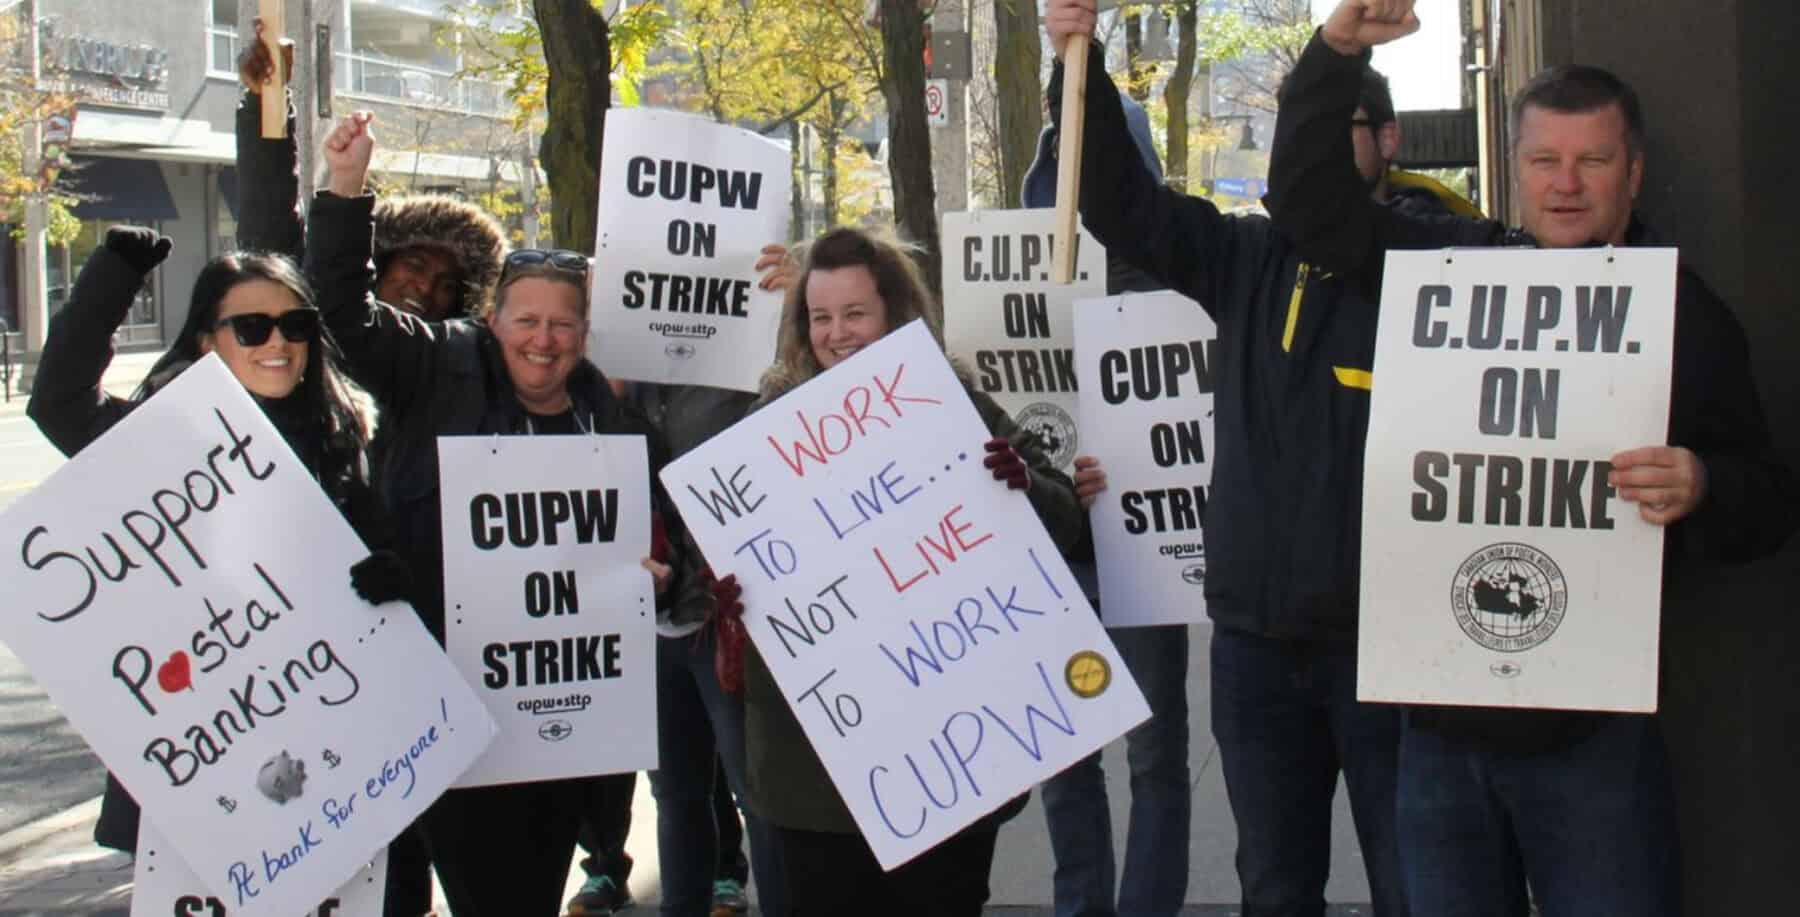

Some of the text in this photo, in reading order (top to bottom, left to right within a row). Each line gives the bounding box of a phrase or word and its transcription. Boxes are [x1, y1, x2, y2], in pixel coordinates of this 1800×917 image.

[626, 156, 762, 210] CUPW
[667, 219, 716, 257] ON
[964, 234, 1088, 282] C.U.P..
[622, 270, 751, 318] STRIKE
[1003, 293, 1051, 338] ON
[1412, 284, 1640, 354] C.U.P.W.
[976, 349, 1079, 392] STRIK
[1478, 366, 1560, 440] ON
[688, 464, 767, 525] WE
[767, 364, 942, 477] WORK
[1150, 420, 1205, 468] ON
[21, 408, 276, 623] Support
[1121, 485, 1209, 535] STRI
[1411, 451, 1617, 530] STRIKE
[469, 488, 618, 550] CUPW
[873, 504, 993, 593] LIVE
[524, 570, 579, 618] ON
[482, 634, 622, 690] STRIKE
[869, 661, 1076, 839] CUPW
[262, 820, 322, 883] bank
[322, 792, 358, 828] for
[366, 697, 455, 800] everyone!
